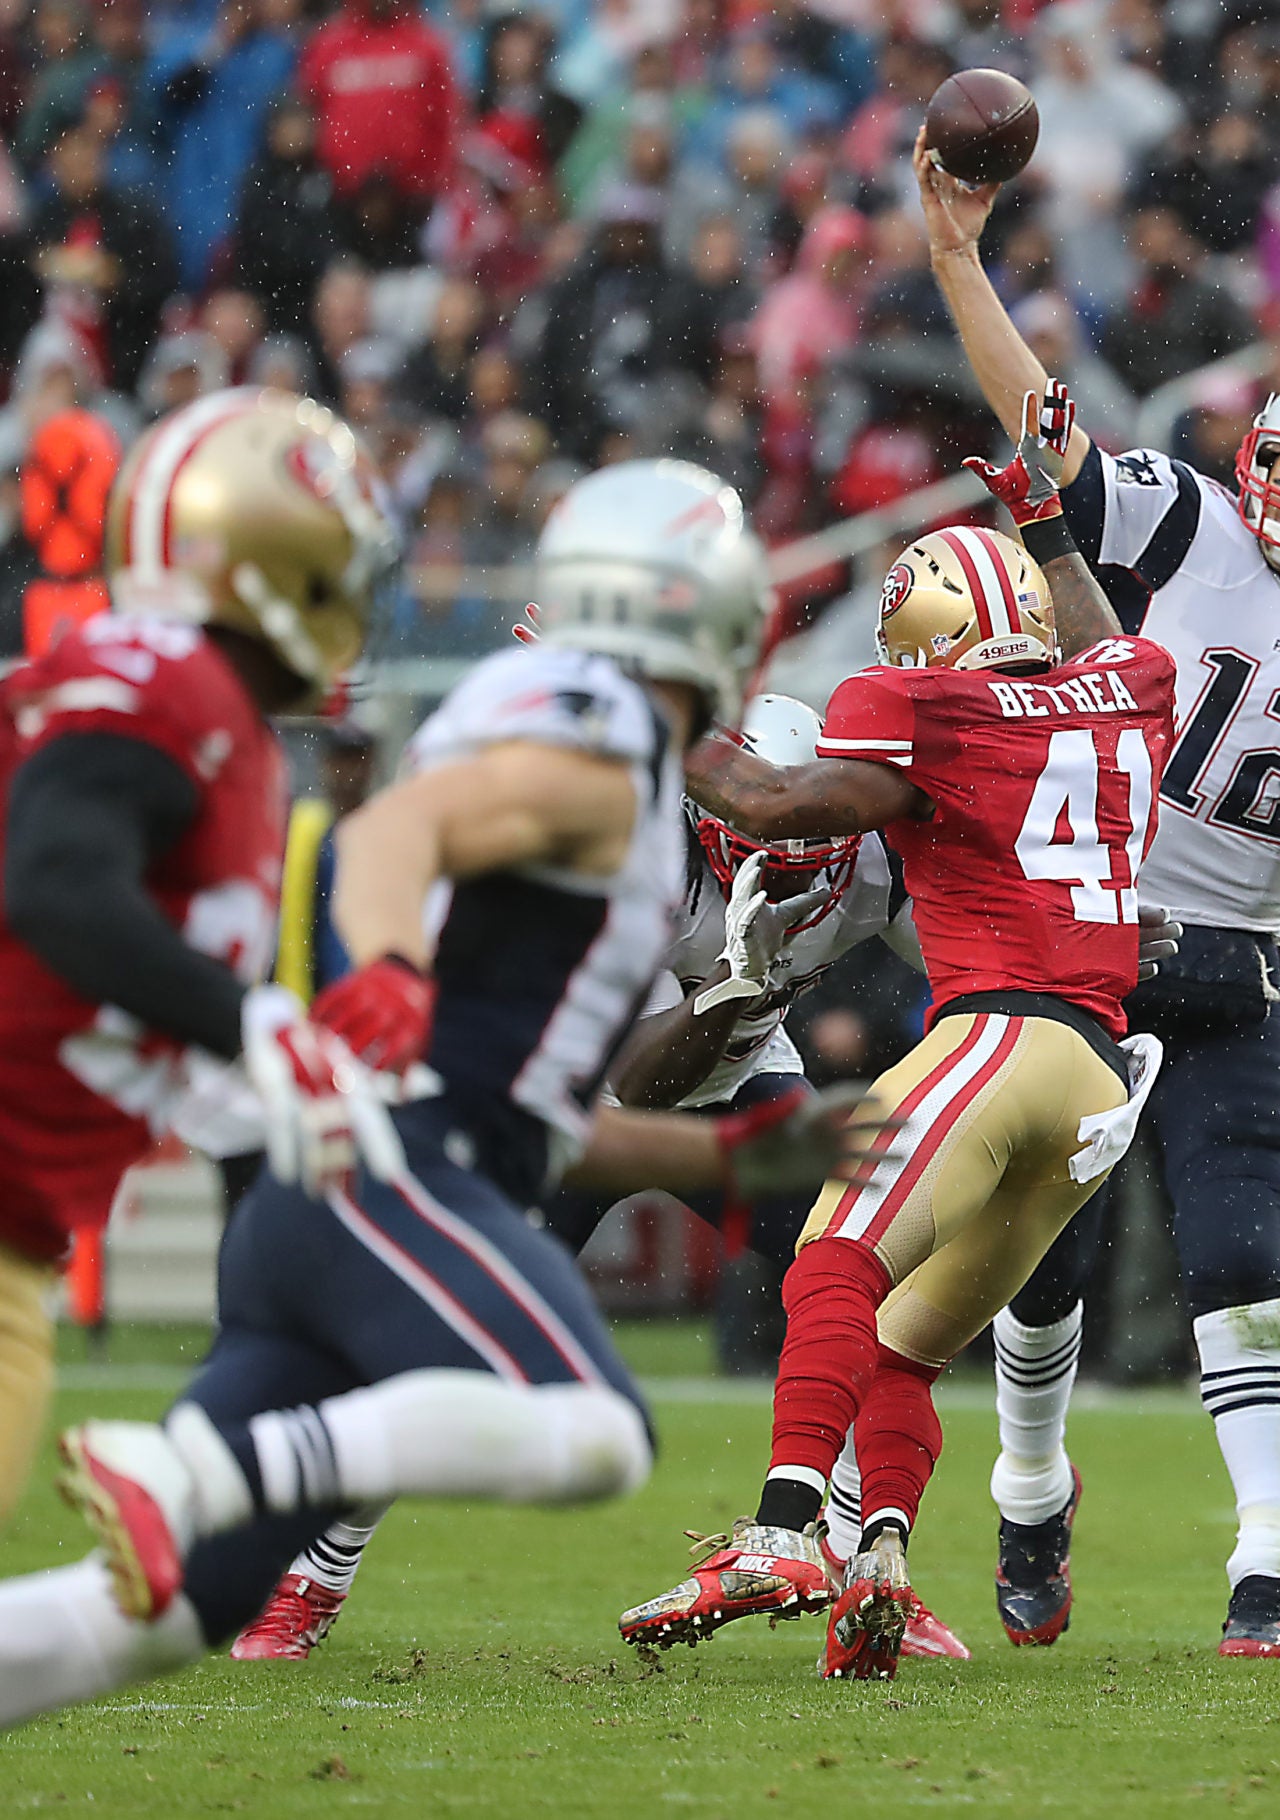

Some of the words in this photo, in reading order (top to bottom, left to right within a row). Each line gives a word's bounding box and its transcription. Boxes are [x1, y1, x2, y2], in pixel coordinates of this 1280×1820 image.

[978, 641, 1029, 660] 49ERS
[987, 670, 1139, 717] BETHEA
[1014, 729, 1158, 924] 41
[731, 1554, 778, 1573] NIKE
